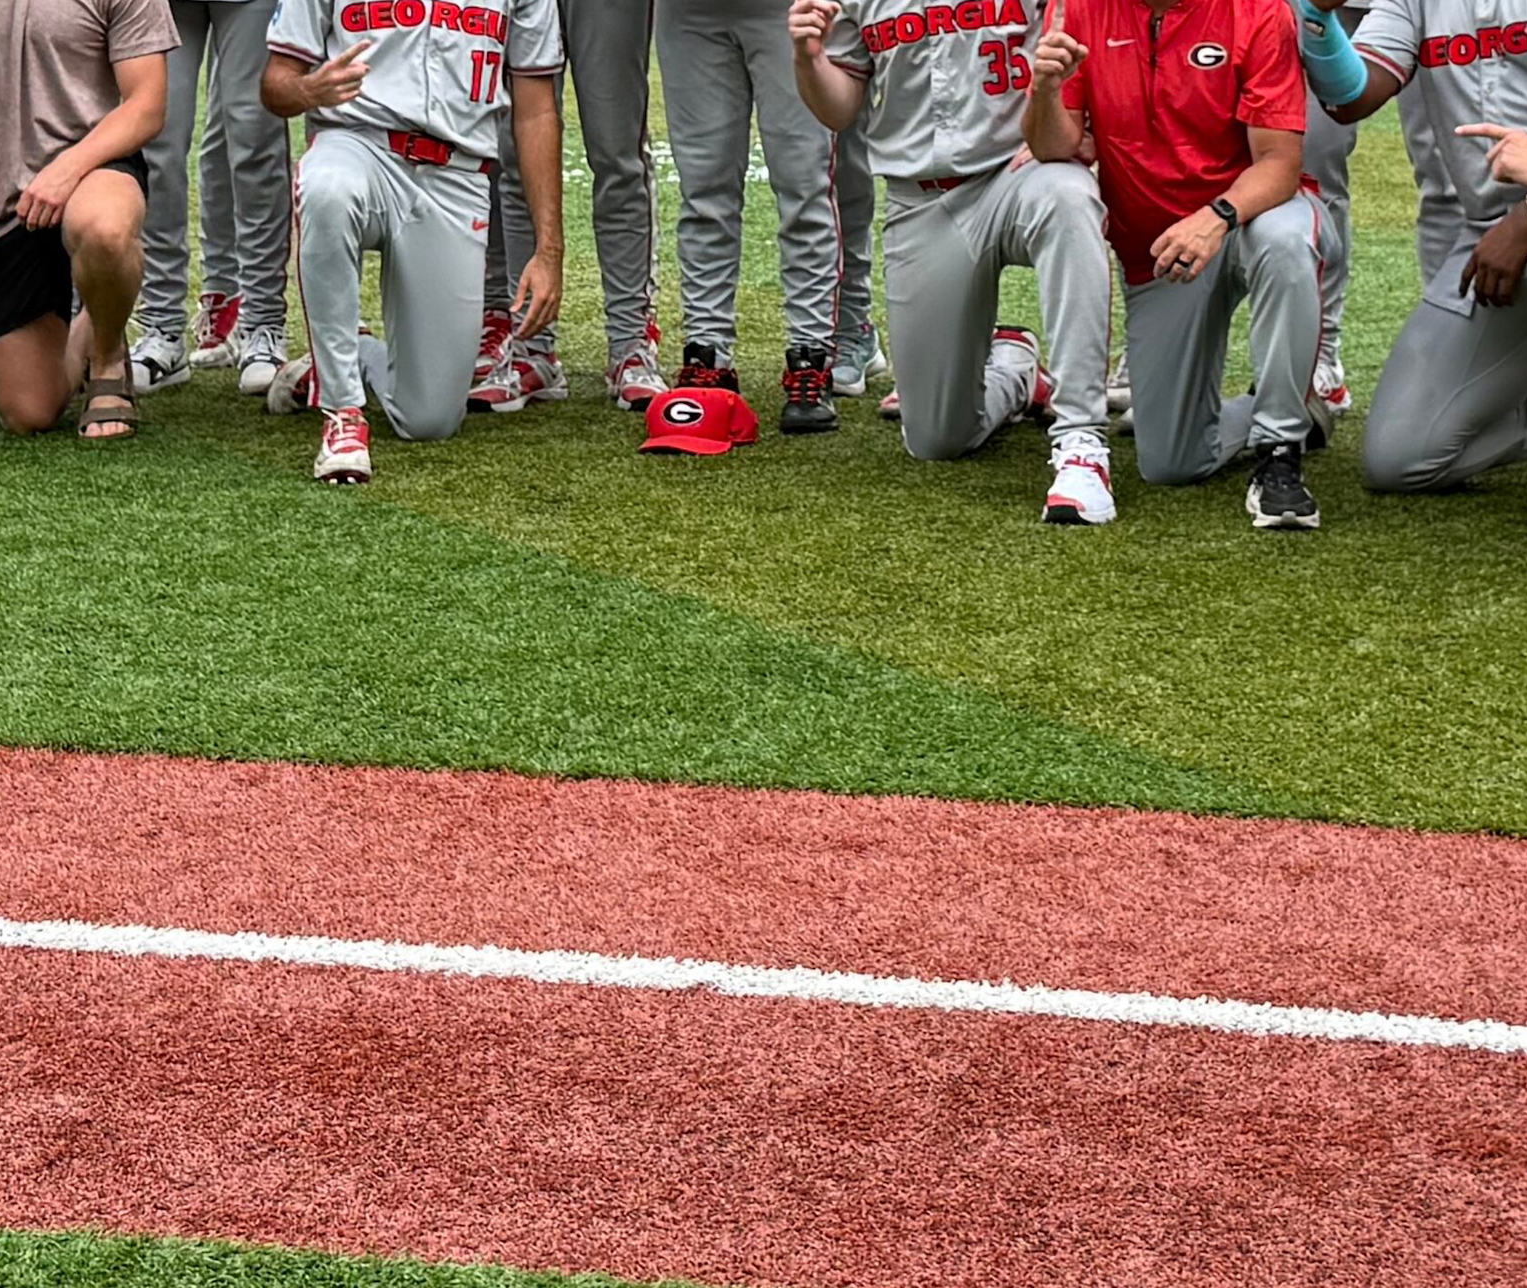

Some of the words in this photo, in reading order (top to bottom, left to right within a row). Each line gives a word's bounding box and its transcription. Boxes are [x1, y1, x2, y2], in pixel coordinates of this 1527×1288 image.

[978, 35, 1031, 96] 35
[1191, 44, 1226, 67] G
[469, 50, 501, 104] 17
[665, 400, 704, 423] G
